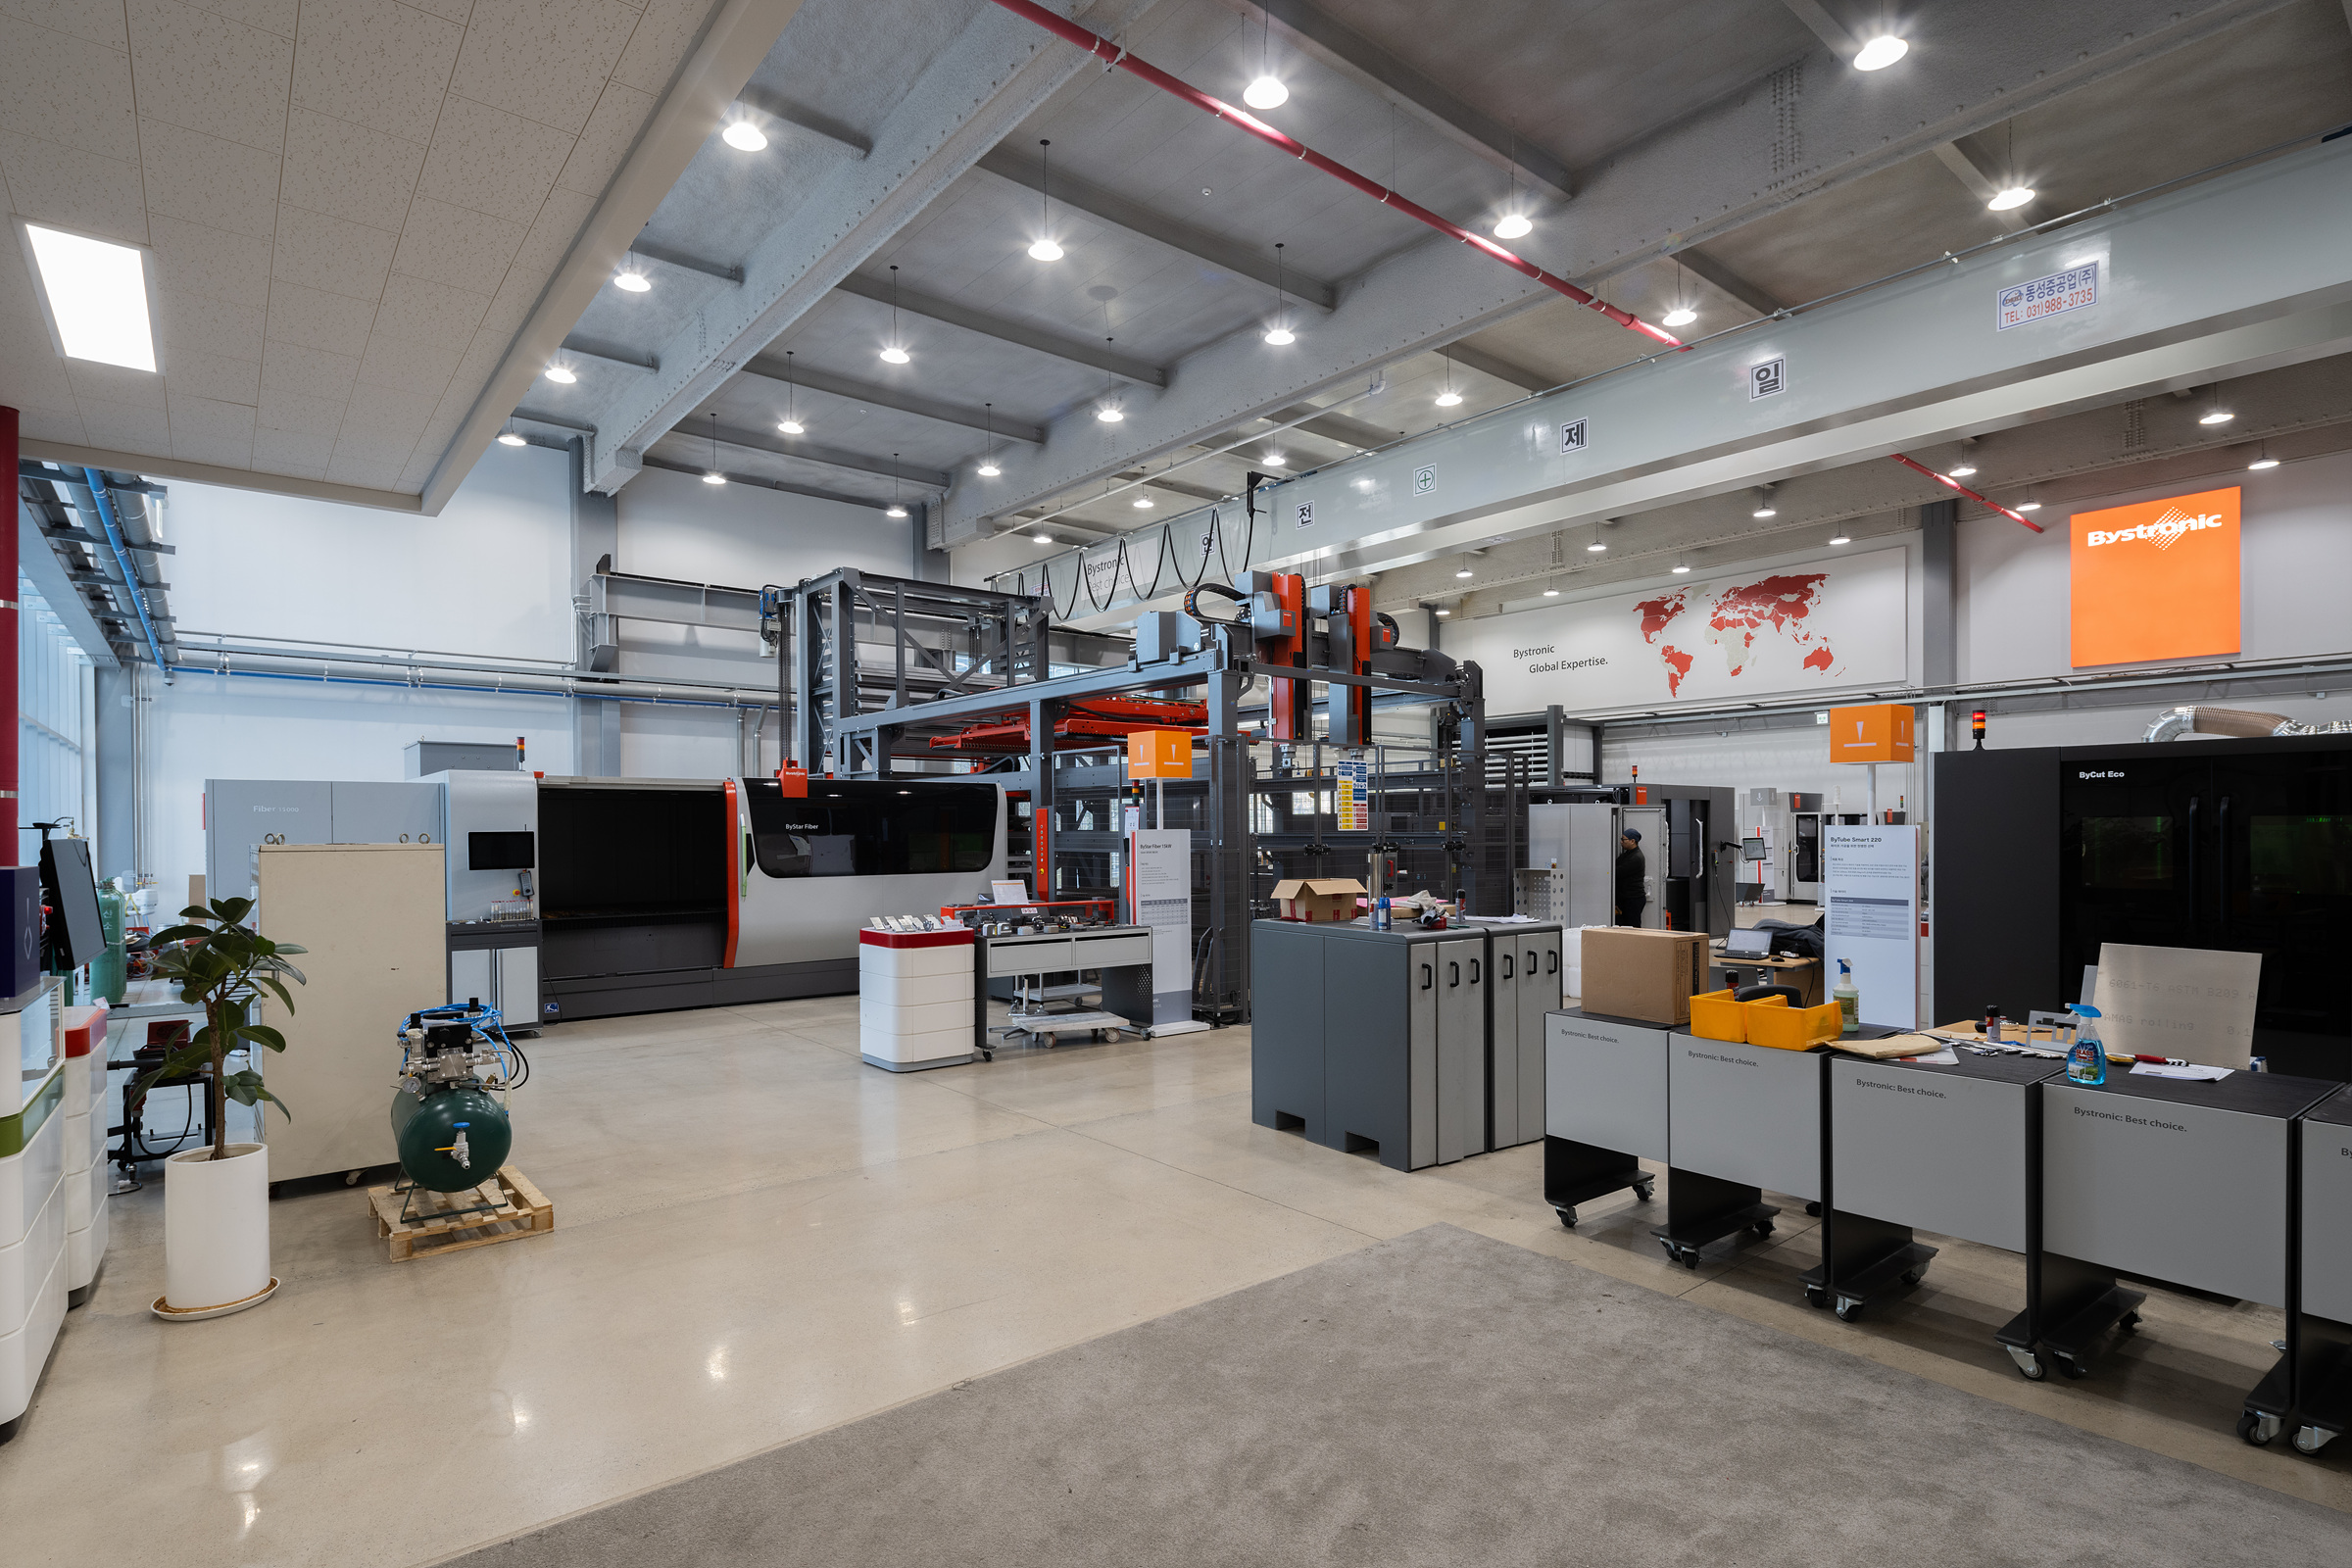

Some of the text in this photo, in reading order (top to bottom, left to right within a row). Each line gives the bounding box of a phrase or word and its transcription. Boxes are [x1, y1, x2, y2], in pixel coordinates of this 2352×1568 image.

[2004, 310, 2024, 324] TEL:
[1298, 504, 1312, 525] 전
[1564, 421, 1585, 447] 제
[1755, 363, 1780, 395] 일
[2087, 514, 2223, 548] Bystronic
[1087, 556, 1125, 577] Bystronc
[1513, 644, 1555, 660] Bystronic
[1529, 657, 1608, 674] Global Expertise.
[2079, 770, 2106, 780] ByCut
[2168, 984, 2199, 996] ASTM
[2140, 1018, 2196, 1031] rolling
[1688, 1050, 1759, 1067] Bystronic: Best choice.
[1856, 1078, 1947, 1100] Bystronic: Best choice.
[2074, 1106, 2187, 1133] Bystronic: Best choice.
